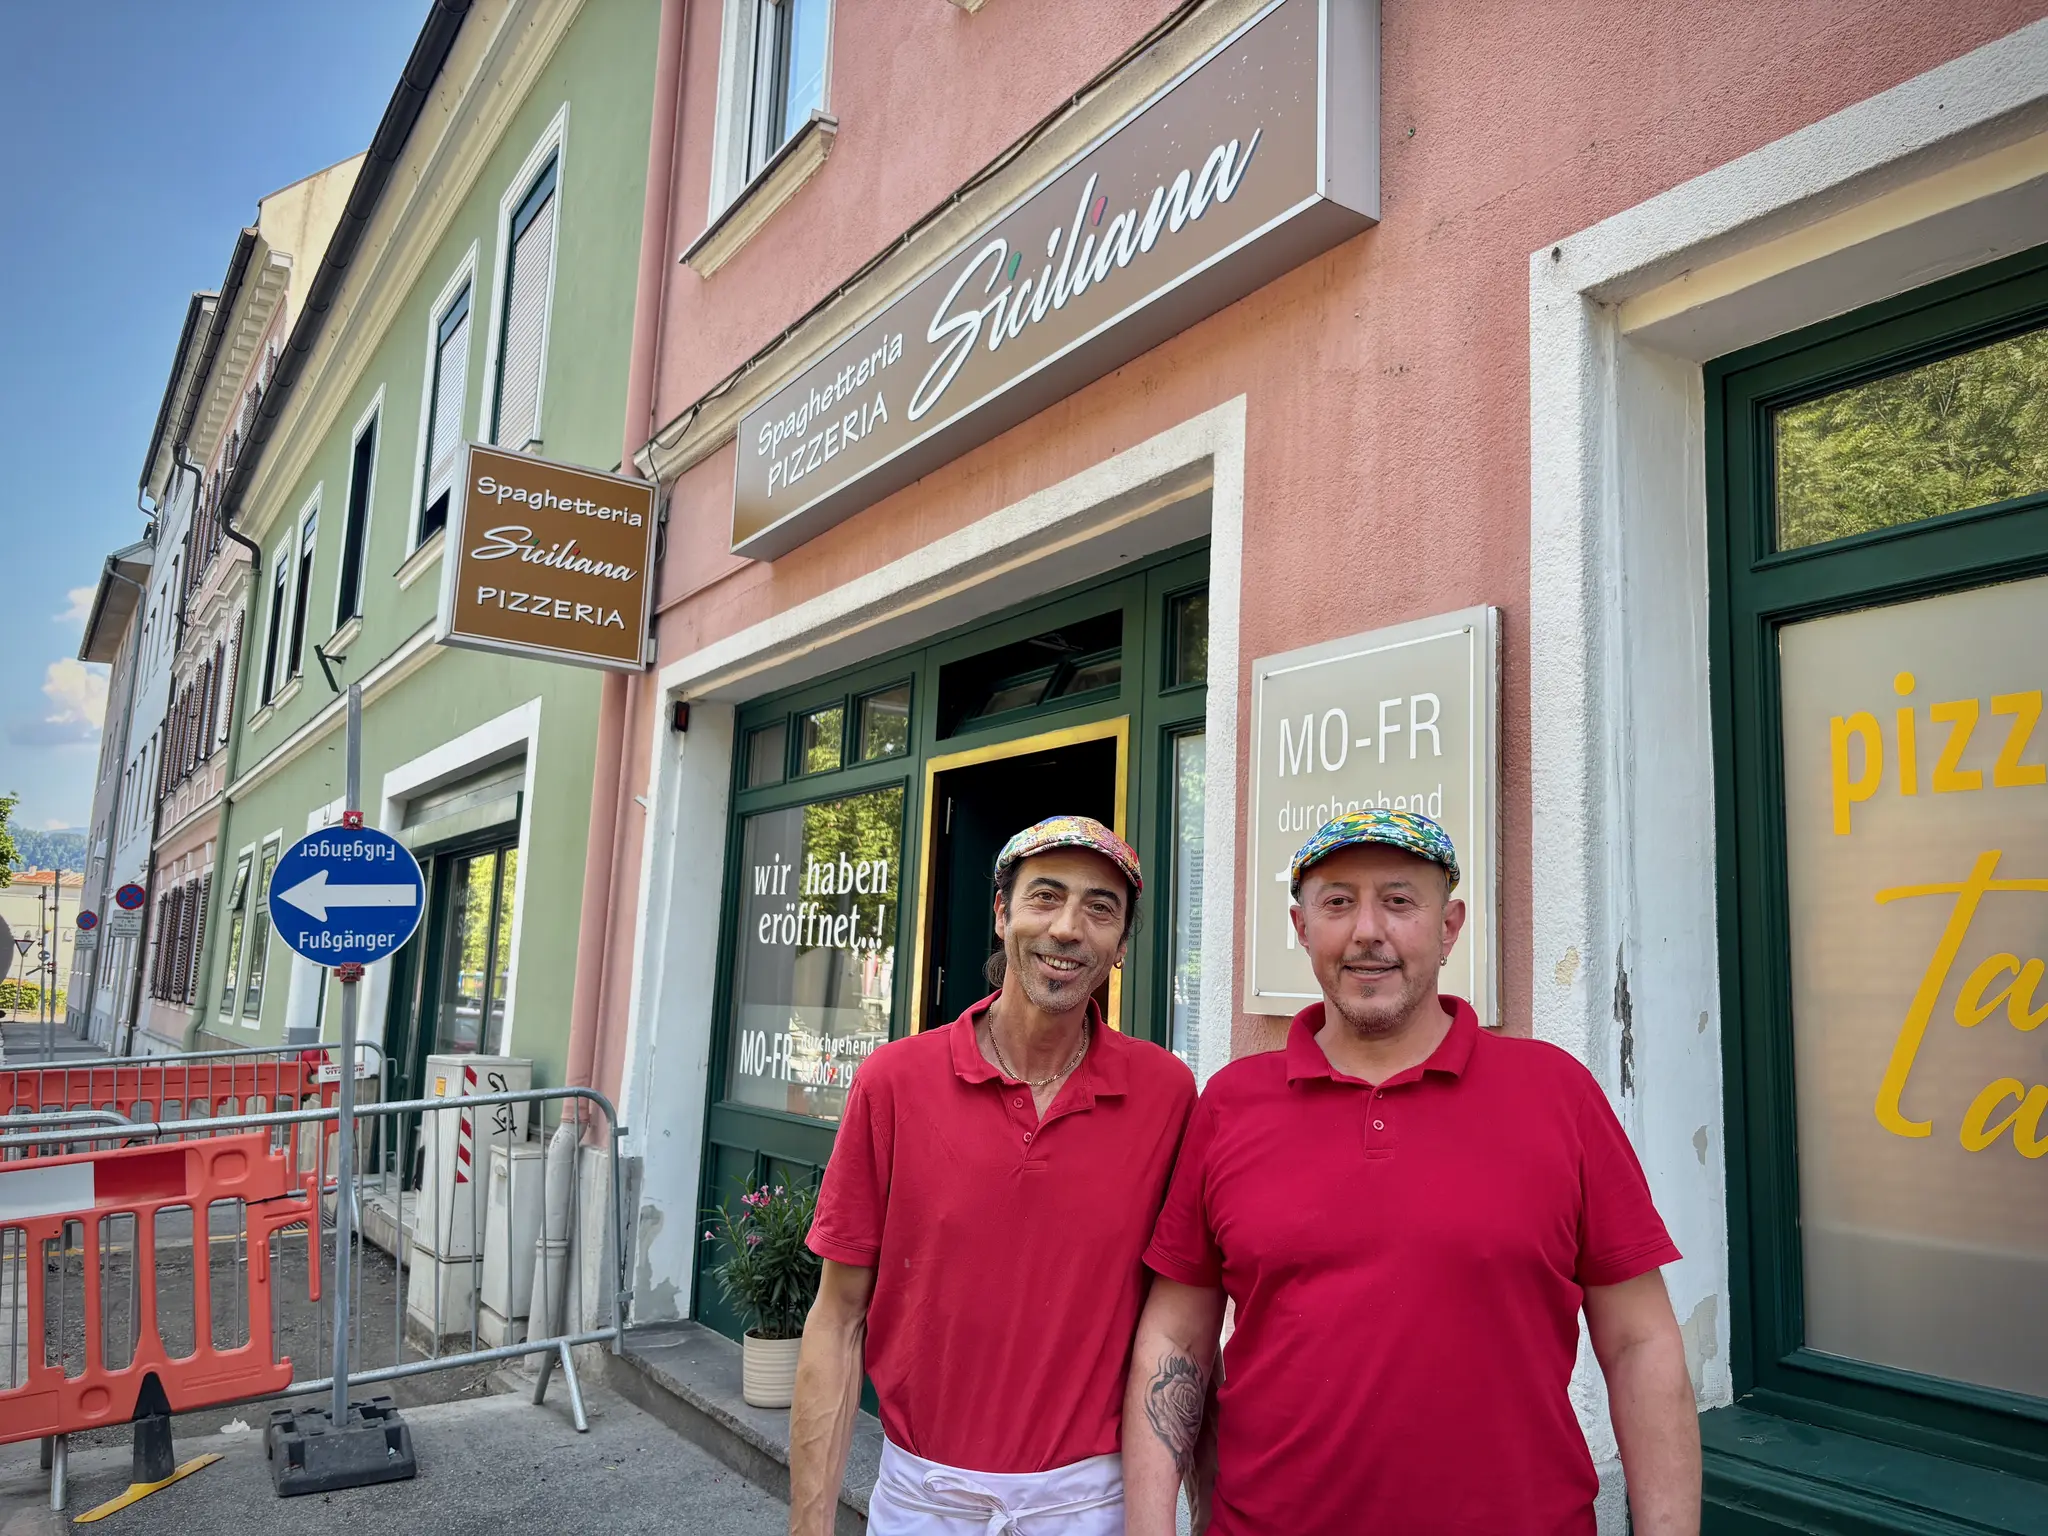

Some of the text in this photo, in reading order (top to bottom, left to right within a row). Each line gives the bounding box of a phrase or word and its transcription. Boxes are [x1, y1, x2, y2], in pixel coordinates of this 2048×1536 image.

[908, 128, 1263, 422] Siciliana
[758, 333, 903, 456] Spaghetteria
[766, 391, 889, 498] PIZZERIA
[477, 476, 643, 528] Spaghetteria
[471, 525, 638, 582] Siciliana
[477, 586, 626, 630] PIZZERIA
[1278, 692, 1442, 778] MO-FR
[299, 839, 396, 862] Fußgänger
[754, 851, 889, 896] wir haben
[299, 930, 396, 952] Fußgänger
[739, 1029, 793, 1082] MO-FR
